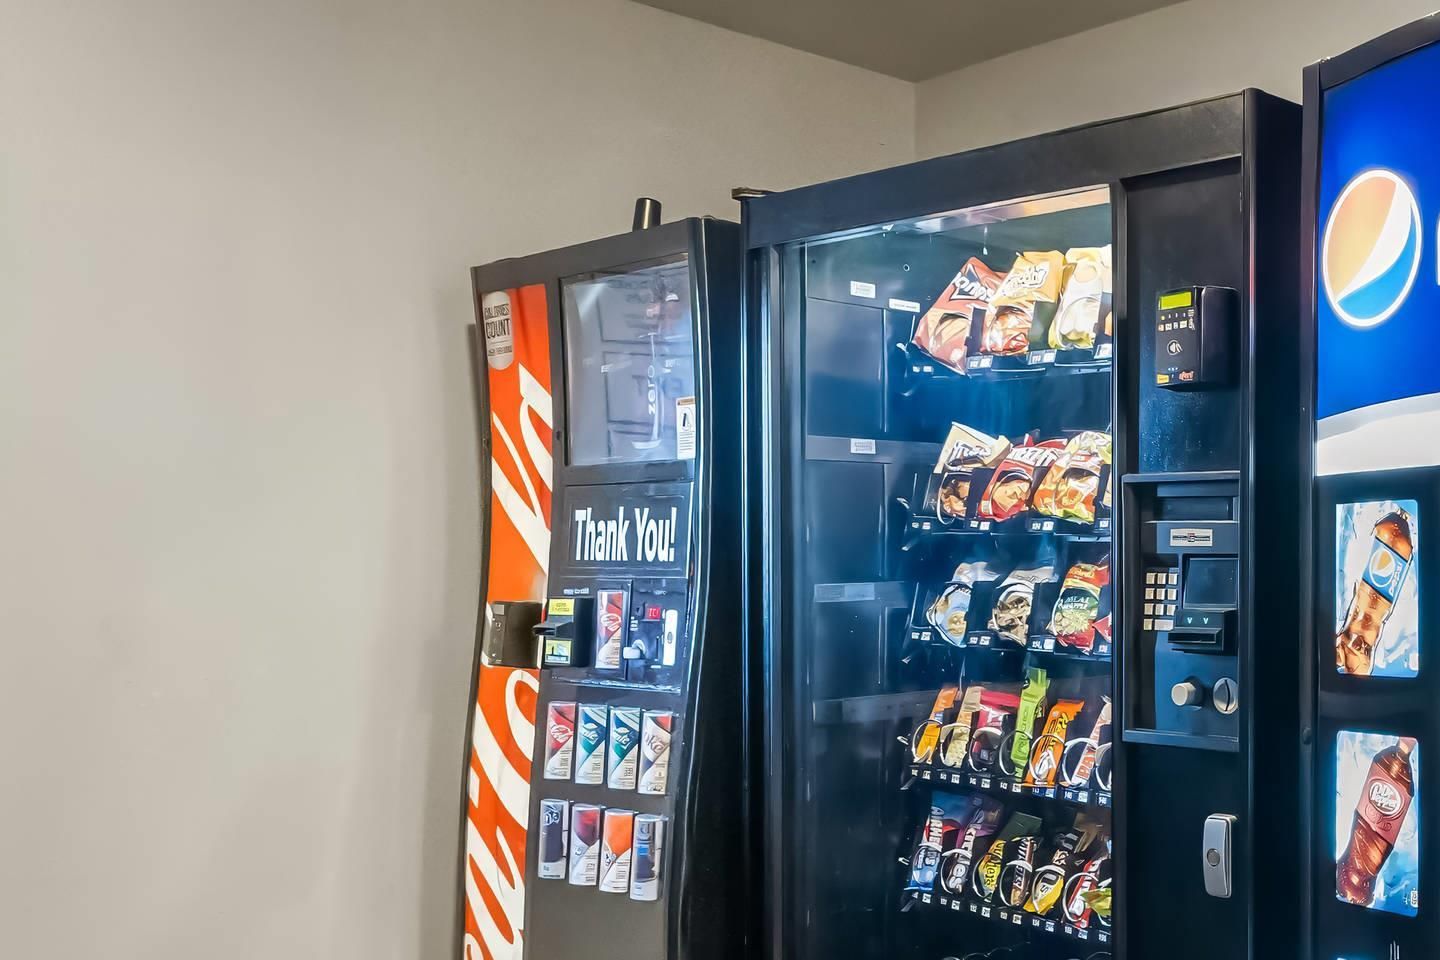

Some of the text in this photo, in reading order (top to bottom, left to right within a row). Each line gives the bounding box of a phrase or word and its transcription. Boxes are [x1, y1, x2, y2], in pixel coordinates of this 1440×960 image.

[485, 318, 511, 340] COUNT
[575, 505, 678, 562] Thank You!
